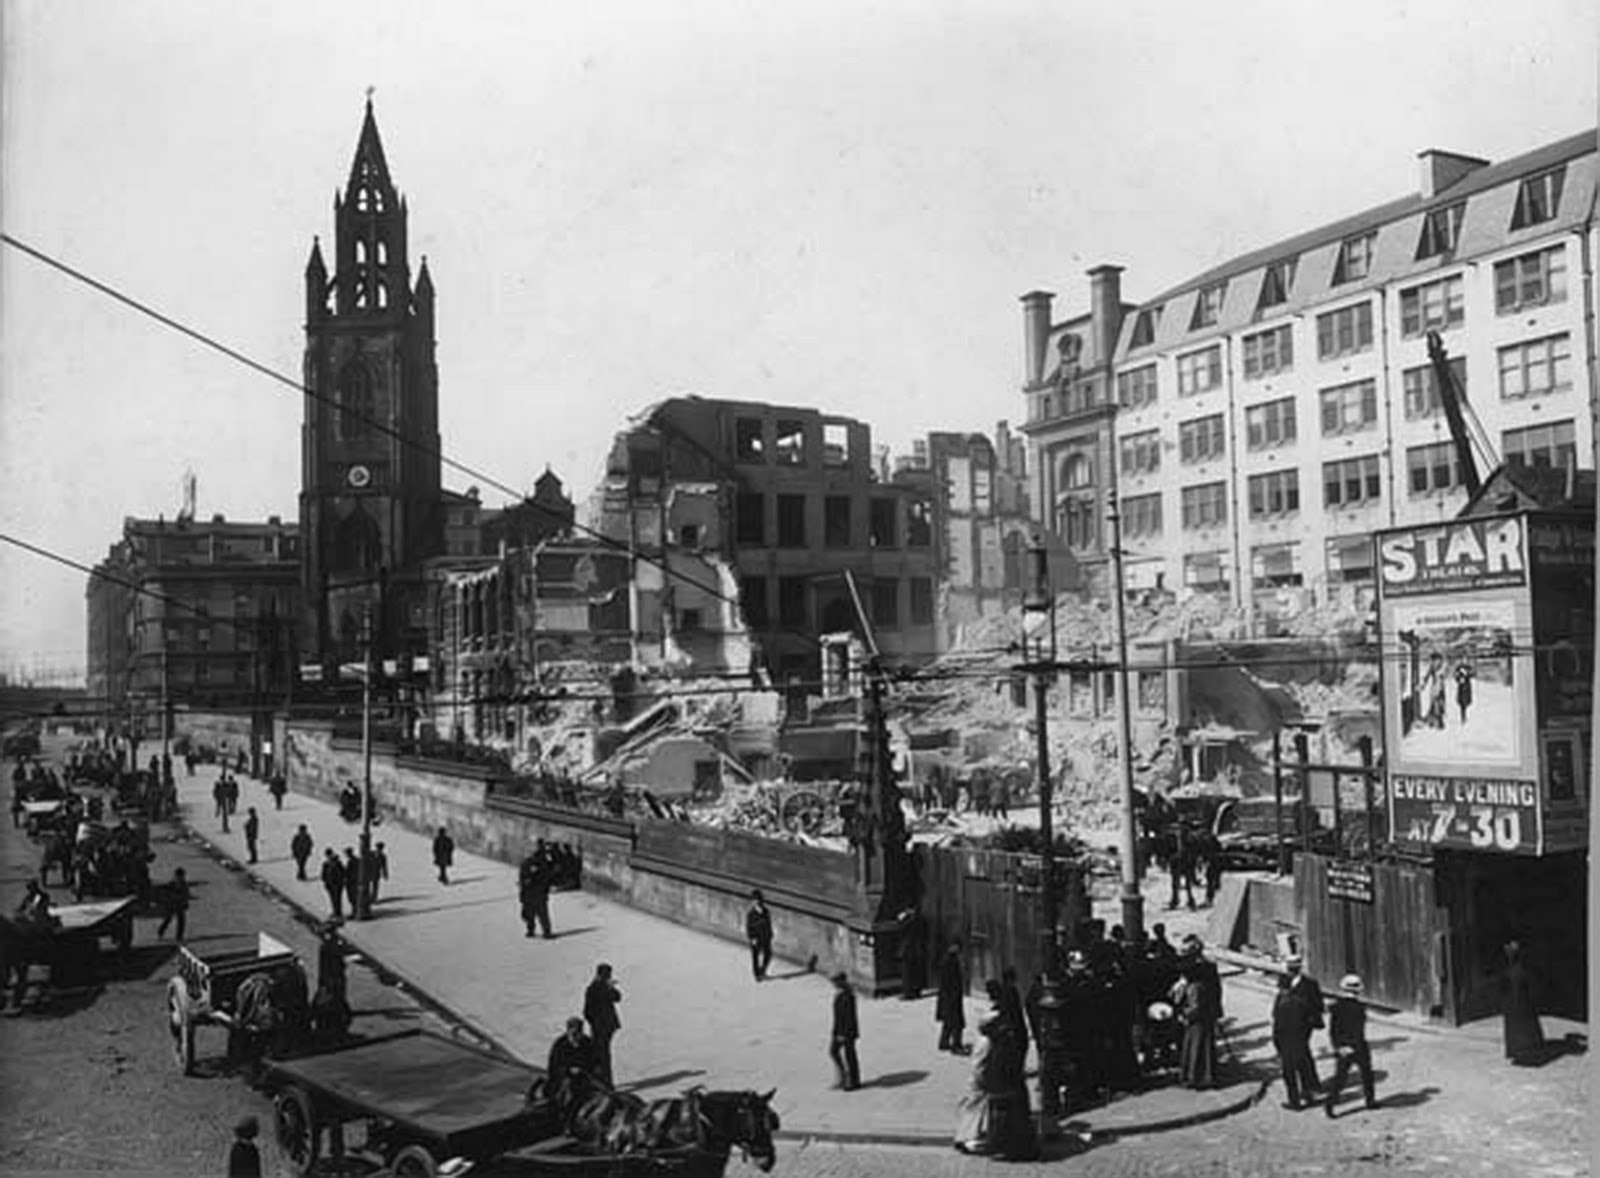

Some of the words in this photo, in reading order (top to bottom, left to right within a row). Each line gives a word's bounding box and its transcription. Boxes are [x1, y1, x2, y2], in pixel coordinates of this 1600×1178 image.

[1382, 519, 1522, 582] STAR
[1394, 777, 1448, 801] EVERY
[1454, 779, 1535, 806] EVENING
[1408, 818, 1431, 842] AT
